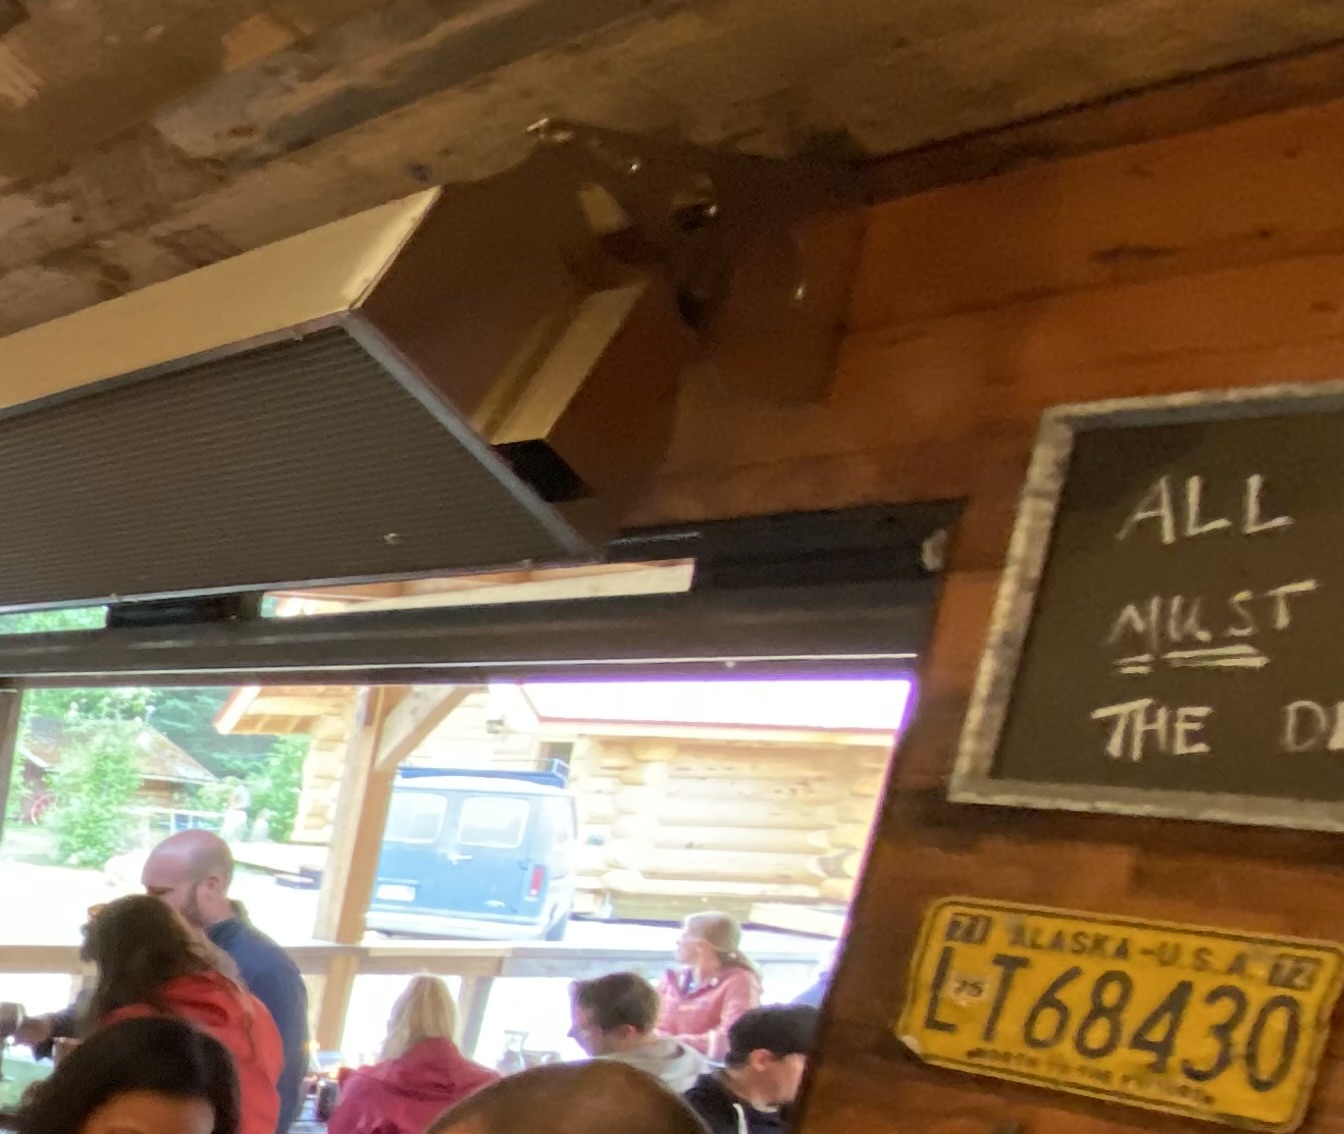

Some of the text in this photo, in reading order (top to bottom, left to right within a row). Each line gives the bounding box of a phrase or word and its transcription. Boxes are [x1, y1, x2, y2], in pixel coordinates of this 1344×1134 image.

[1116, 474, 1295, 545] ALL
[1107, 579, 1319, 653] MUST
[1091, 698, 1214, 762] THE
[923, 946, 1301, 1092] LT68430
